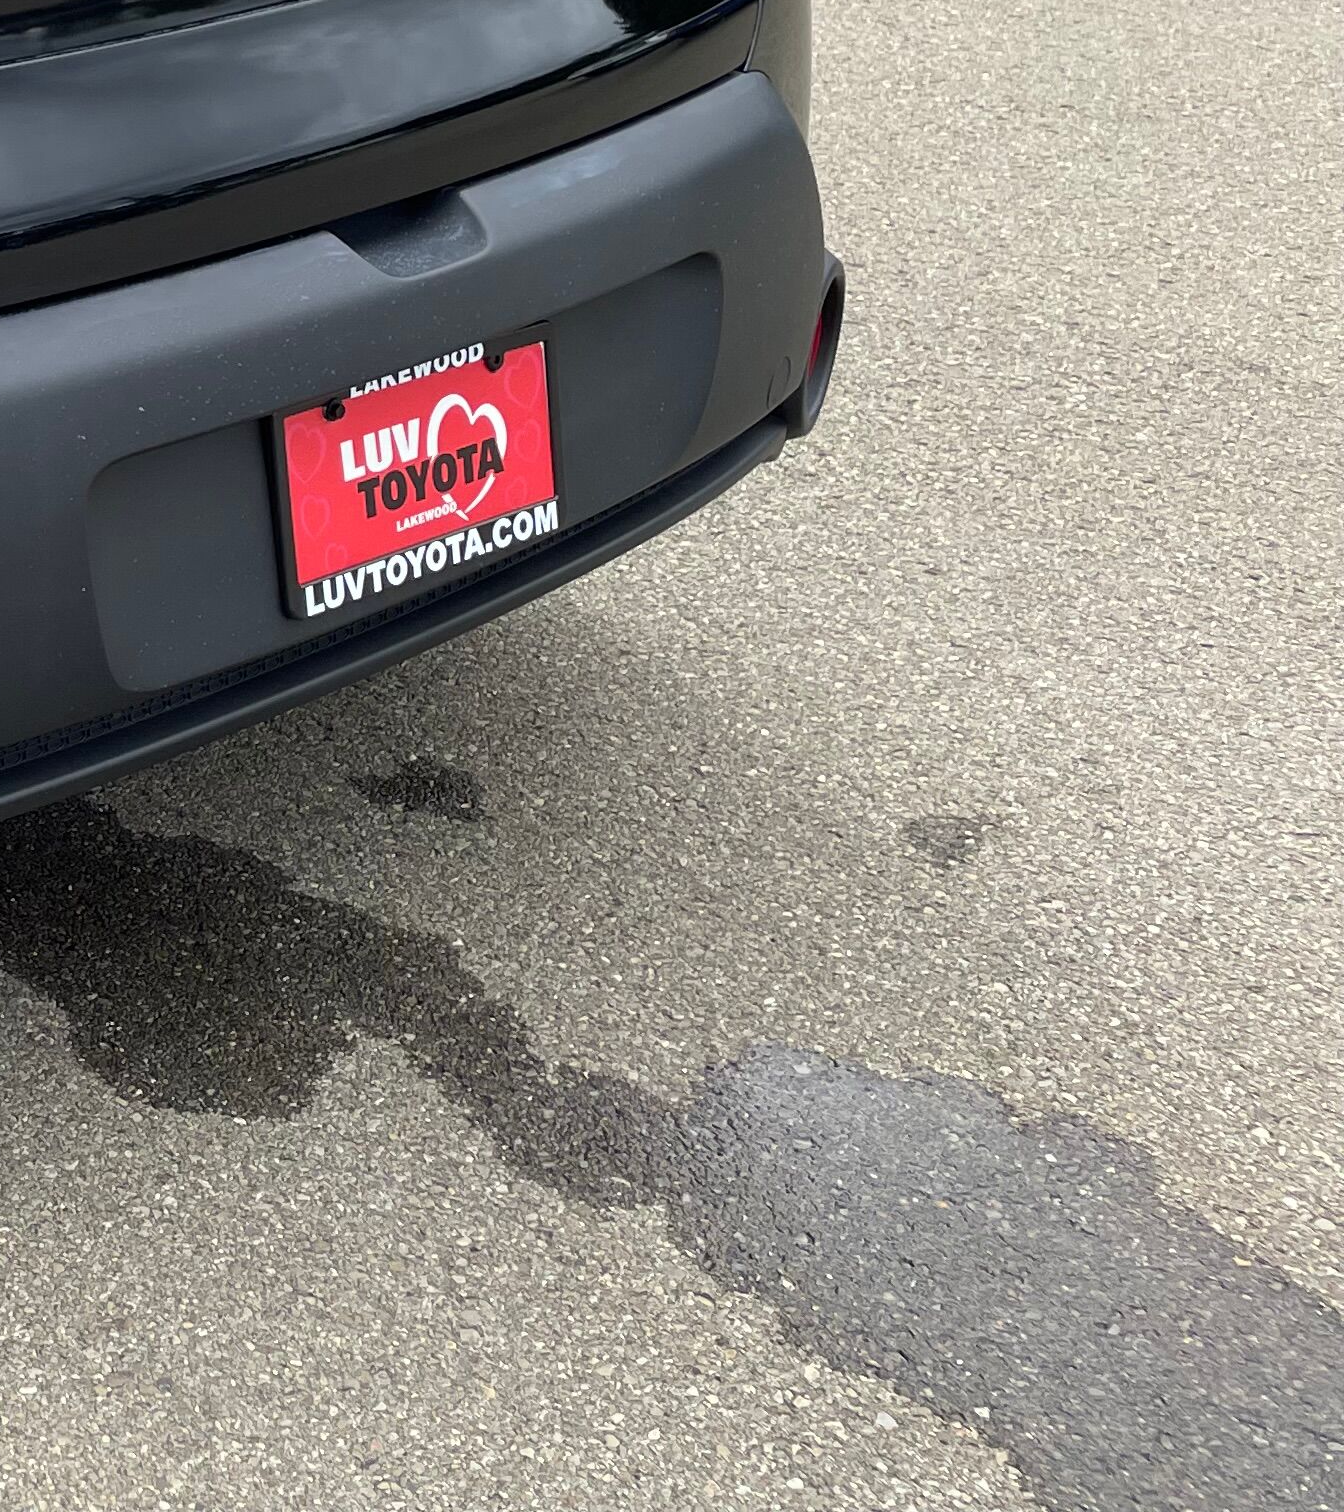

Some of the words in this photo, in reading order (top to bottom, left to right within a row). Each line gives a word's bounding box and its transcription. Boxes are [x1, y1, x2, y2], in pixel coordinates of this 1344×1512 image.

[339, 417, 421, 483] LUV
[357, 438, 505, 519] TOYOTA
[396, 501, 458, 533] LAKEWOOD
[304, 500, 560, 618] LUVTOYOTA.COM
